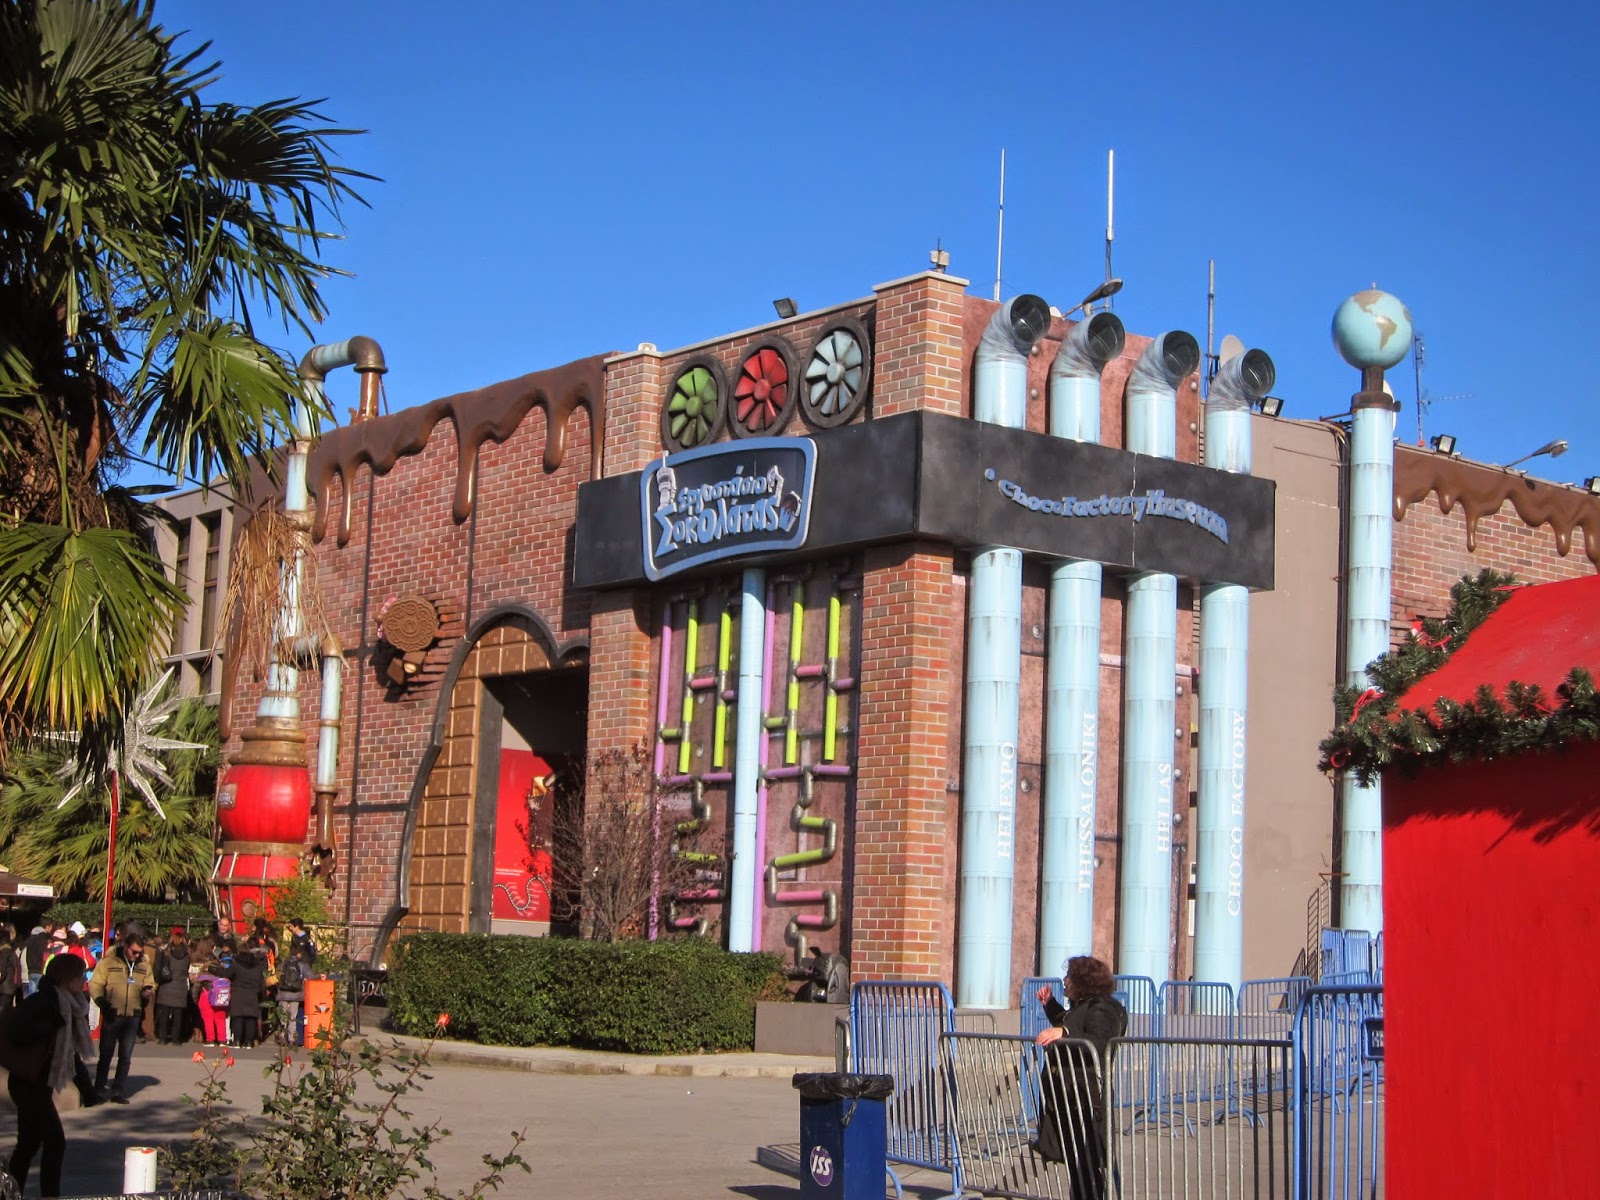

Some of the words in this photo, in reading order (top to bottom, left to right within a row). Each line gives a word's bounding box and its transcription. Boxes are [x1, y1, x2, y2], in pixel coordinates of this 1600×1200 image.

[998, 741, 1015, 858] HELEXPO
[1078, 711, 1096, 893] THESSALONIKI
[1157, 762, 1172, 853] HELLAS
[1231, 711, 1246, 817] FACTORY
[1227, 826, 1244, 917] CHOCO
[812, 1154, 832, 1176] ISS
